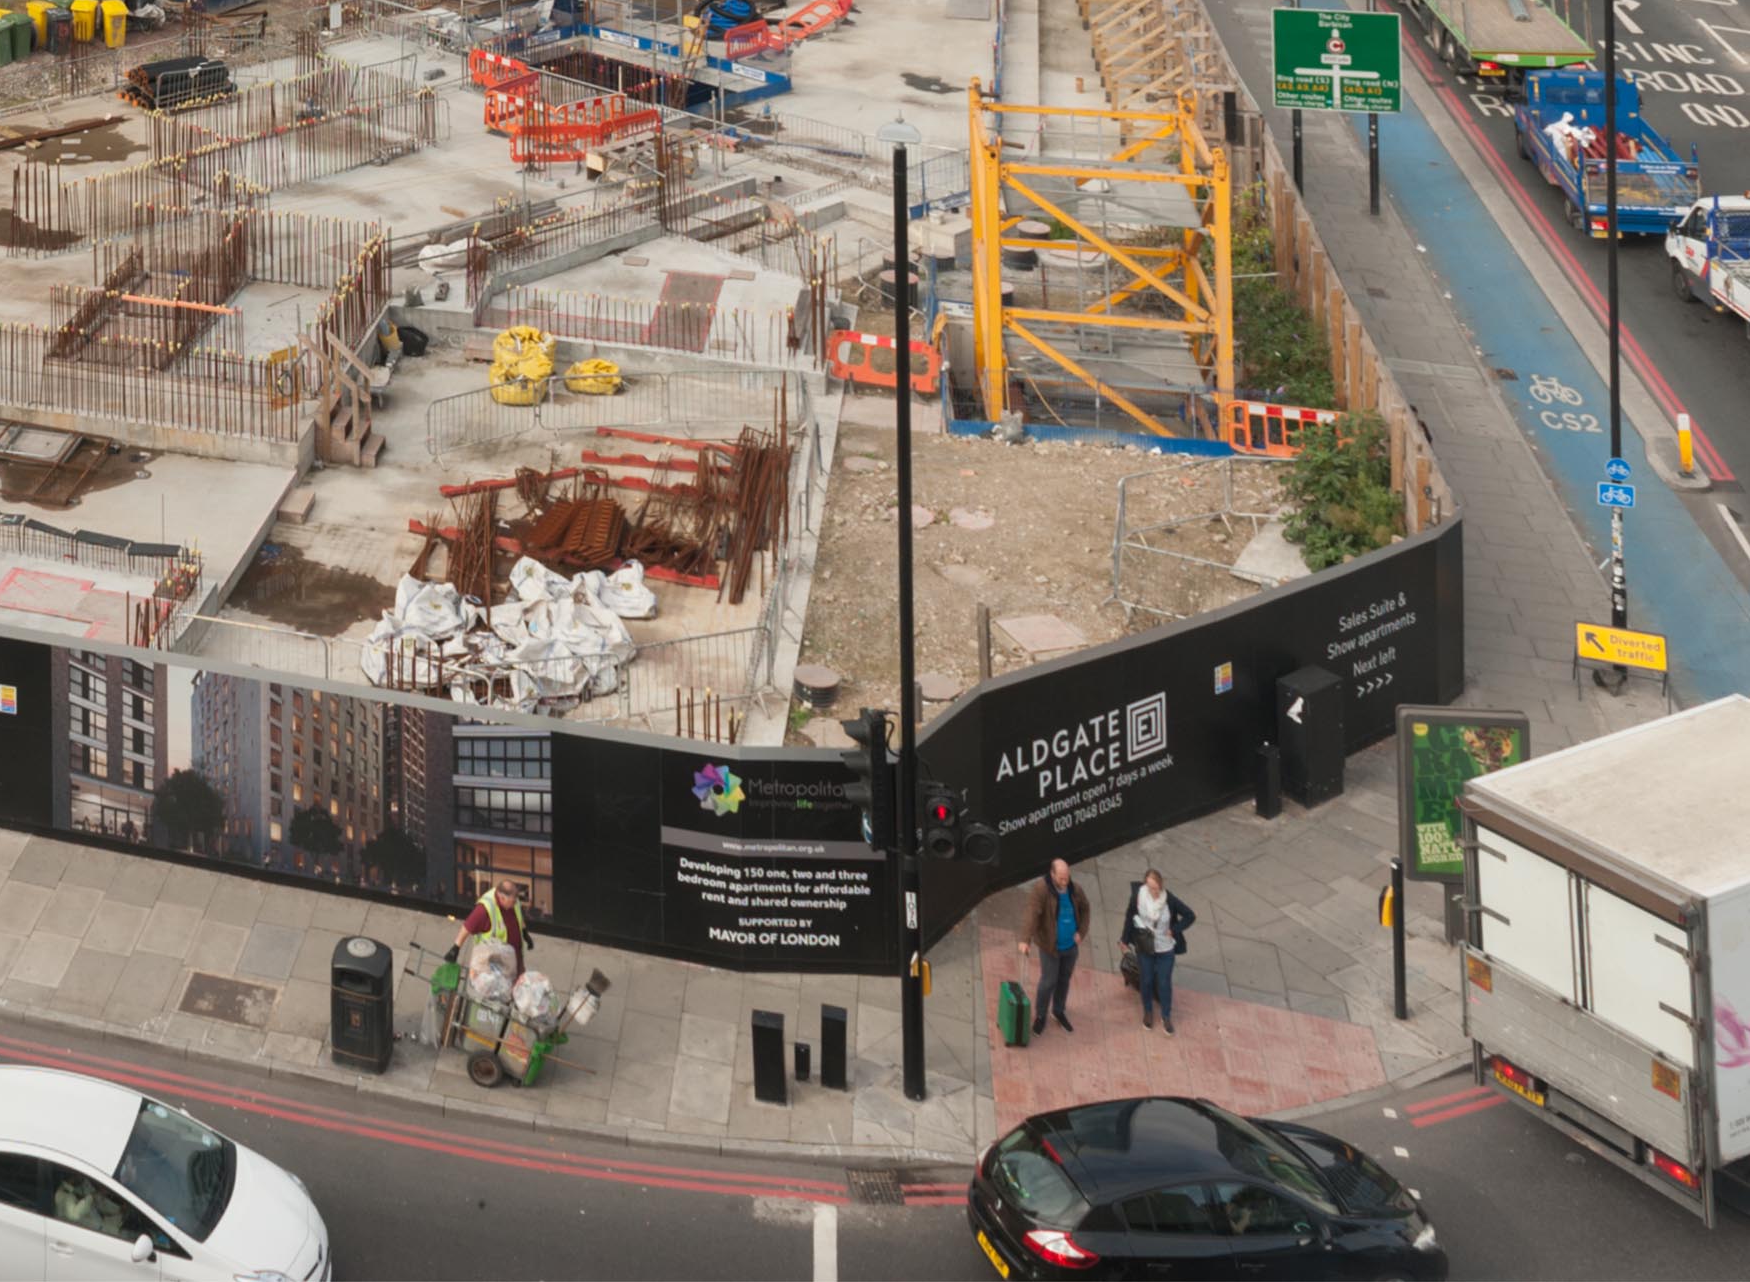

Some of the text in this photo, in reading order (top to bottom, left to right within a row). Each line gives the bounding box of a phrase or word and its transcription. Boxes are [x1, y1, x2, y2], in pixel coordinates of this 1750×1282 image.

[1622, 68, 1745, 95] ROAD
[1540, 410, 1604, 433] CS2
[1339, 591, 1406, 632] Sales Suite &
[1327, 612, 1417, 659] Show apartments
[1609, 634, 1661, 652] Diverted
[1353, 646, 1396, 677] Next left
[1617, 648, 1656, 663] traffic
[996, 709, 1121, 782] ALDGATE
[1039, 741, 1121, 798] PLACE
[749, 778, 848, 801] Metropolita
[999, 753, 1175, 836] Show apartment open 7 days a week
[1054, 793, 1122, 833] 020 7048 0345
[722, 841, 825, 855] www.metropolitan.org.uk
[680, 857, 868, 881] Developing 150 one, two and three
[677, 871, 871, 896] bedroom apartments for affordable
[701, 891, 847, 911] rent and shared ownership
[738, 918, 813, 928] SUPPORTED BY
[709, 927, 840, 946] MAYOR OF LONDON
